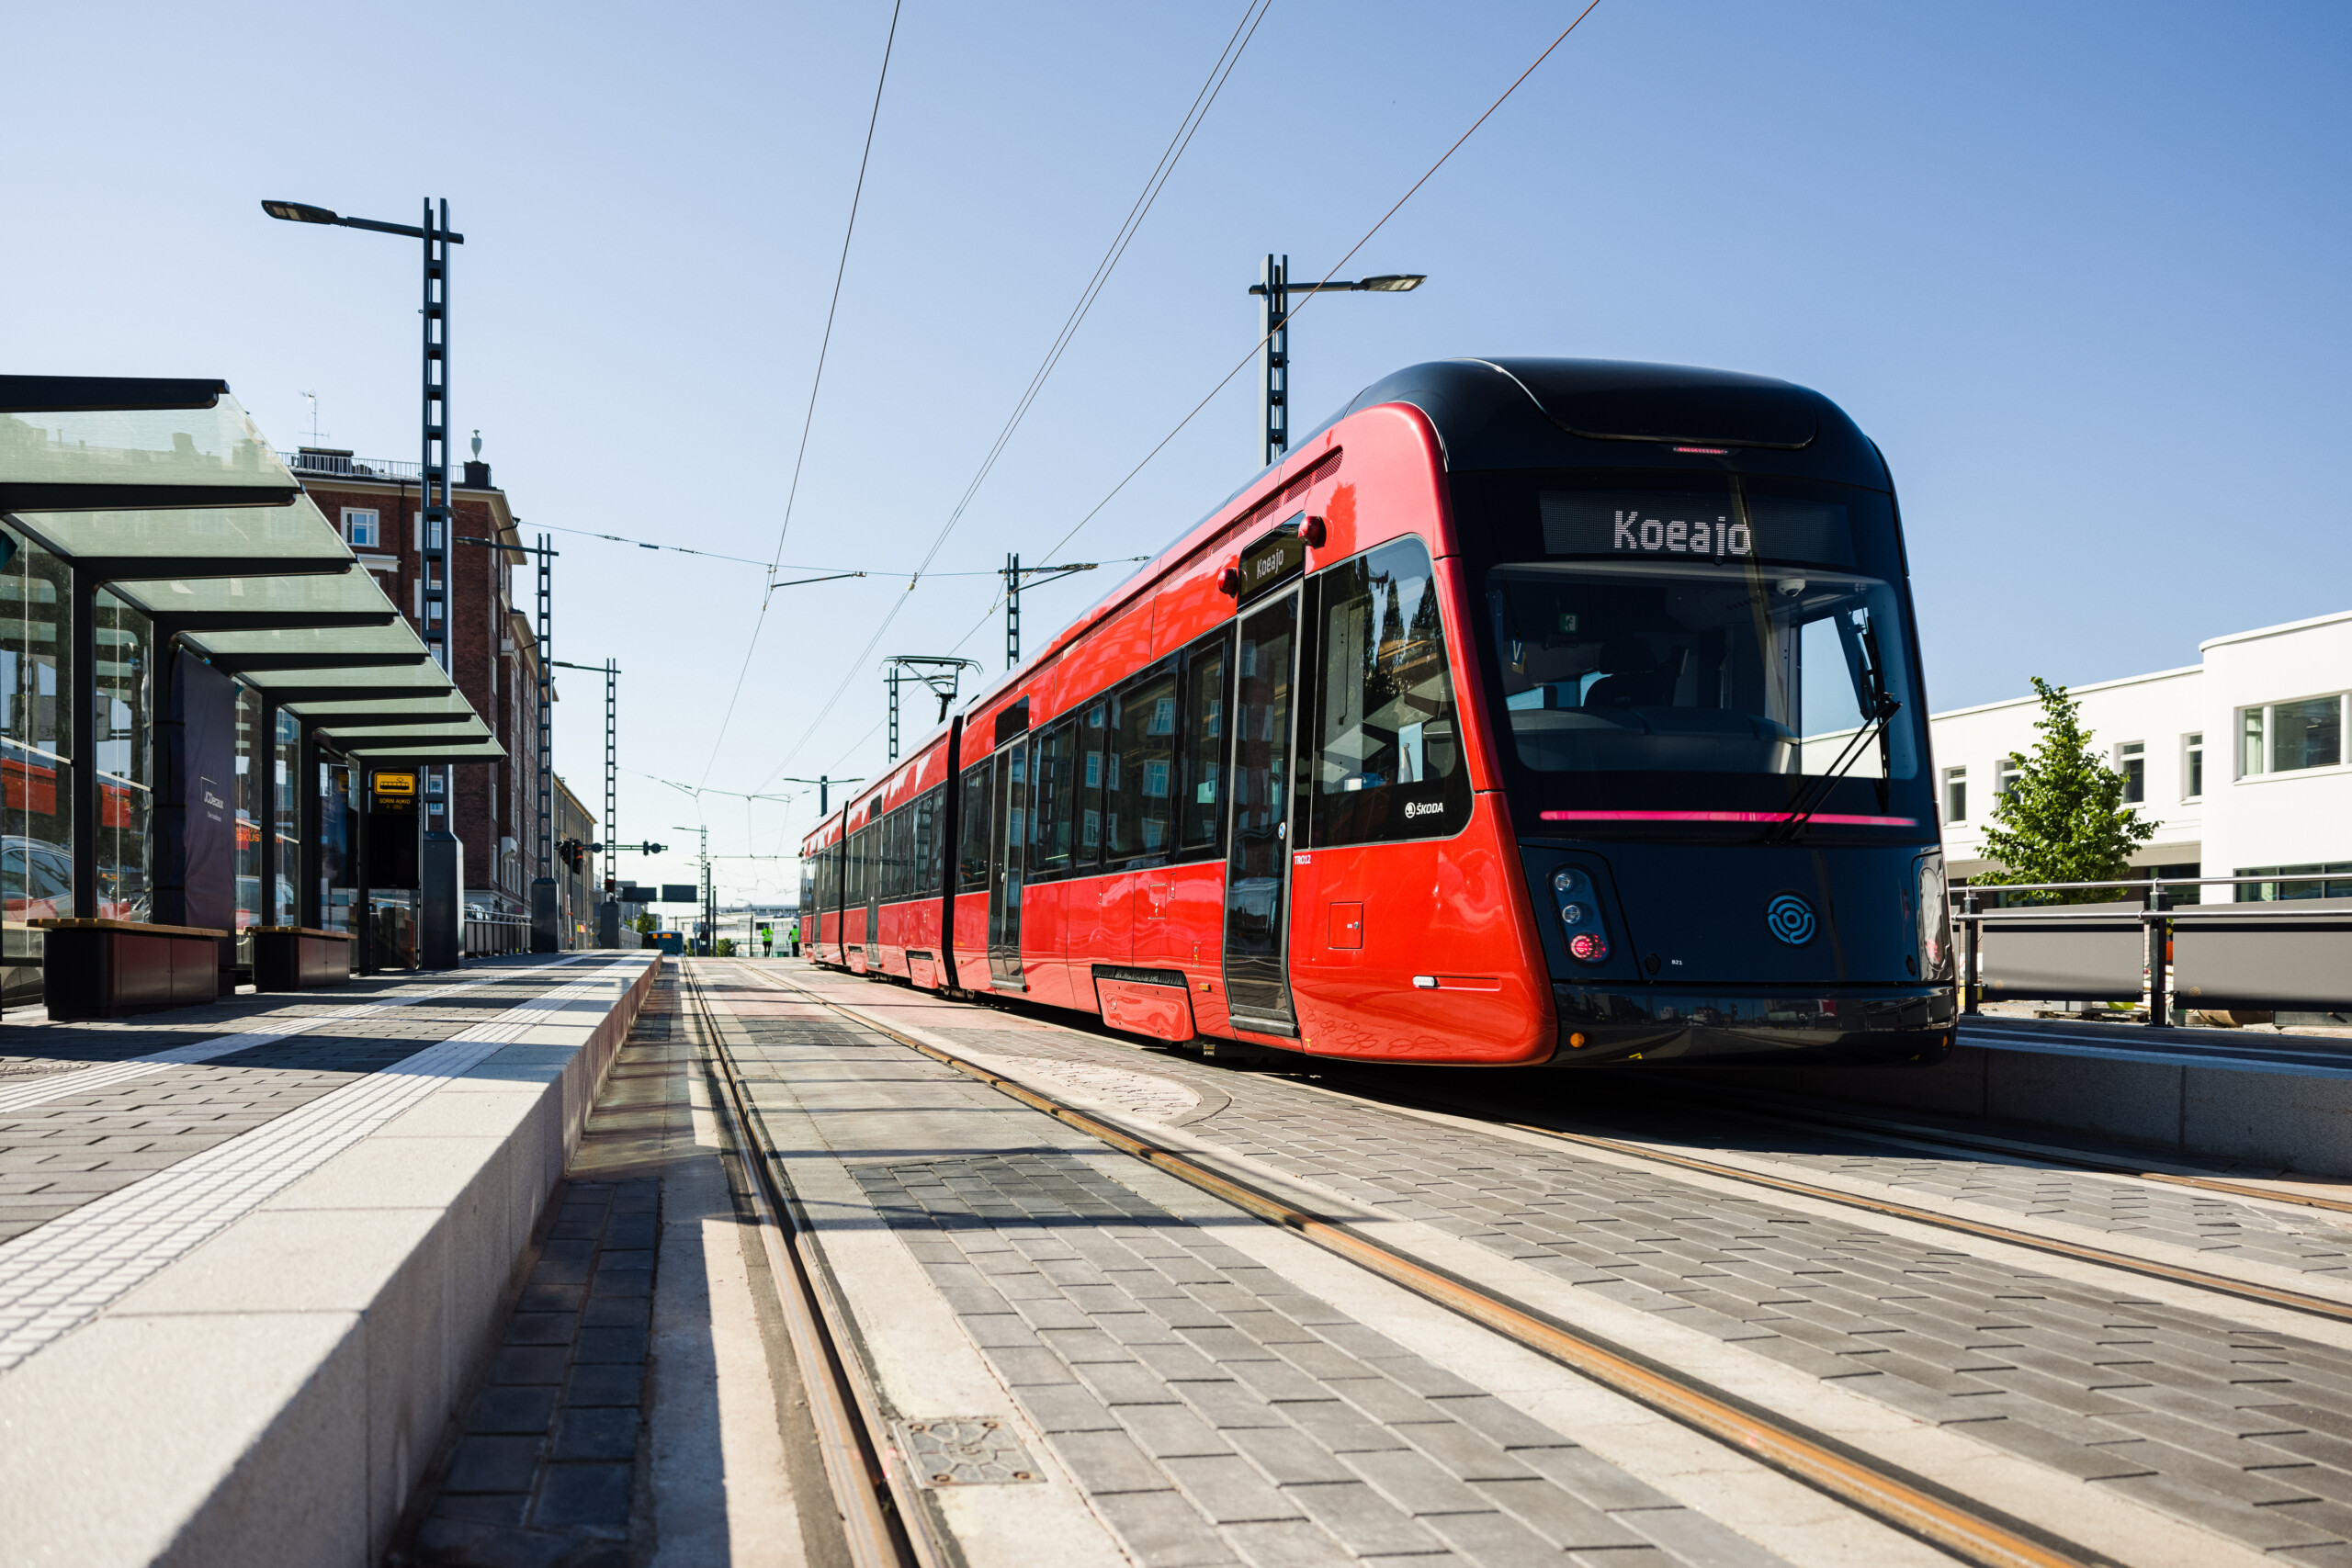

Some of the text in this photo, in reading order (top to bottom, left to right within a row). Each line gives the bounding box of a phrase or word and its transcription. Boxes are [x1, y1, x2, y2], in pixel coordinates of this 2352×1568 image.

[1614, 511, 1751, 556] Koeajo
[1256, 548, 1284, 580] Koeajo
[1416, 802, 1443, 815] ŠKODA
